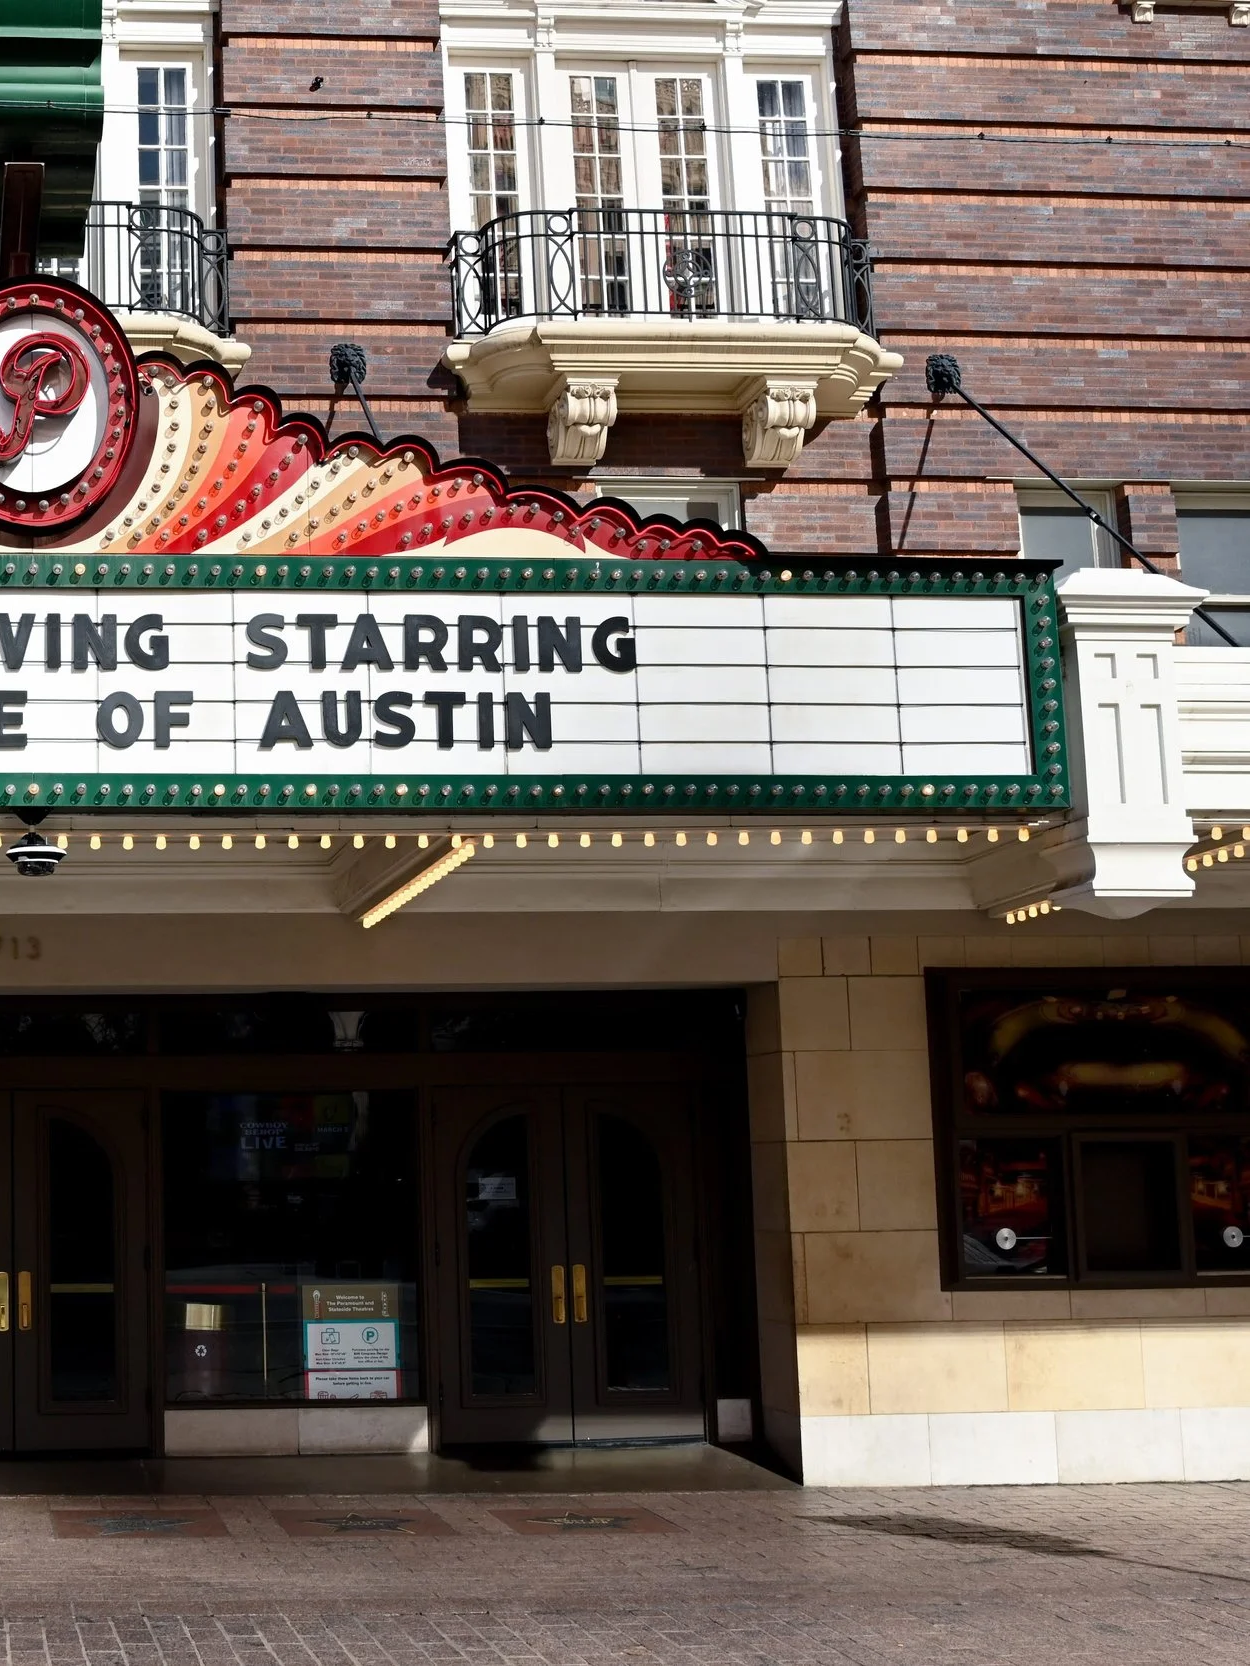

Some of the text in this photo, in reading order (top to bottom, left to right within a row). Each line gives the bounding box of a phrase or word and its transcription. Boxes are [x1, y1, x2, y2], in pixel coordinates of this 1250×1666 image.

[247, 613, 637, 673] STARRING
[96, 690, 191, 748] OF
[261, 691, 553, 750] AUSTIN
[240, 1136, 287, 1149] LIVE
